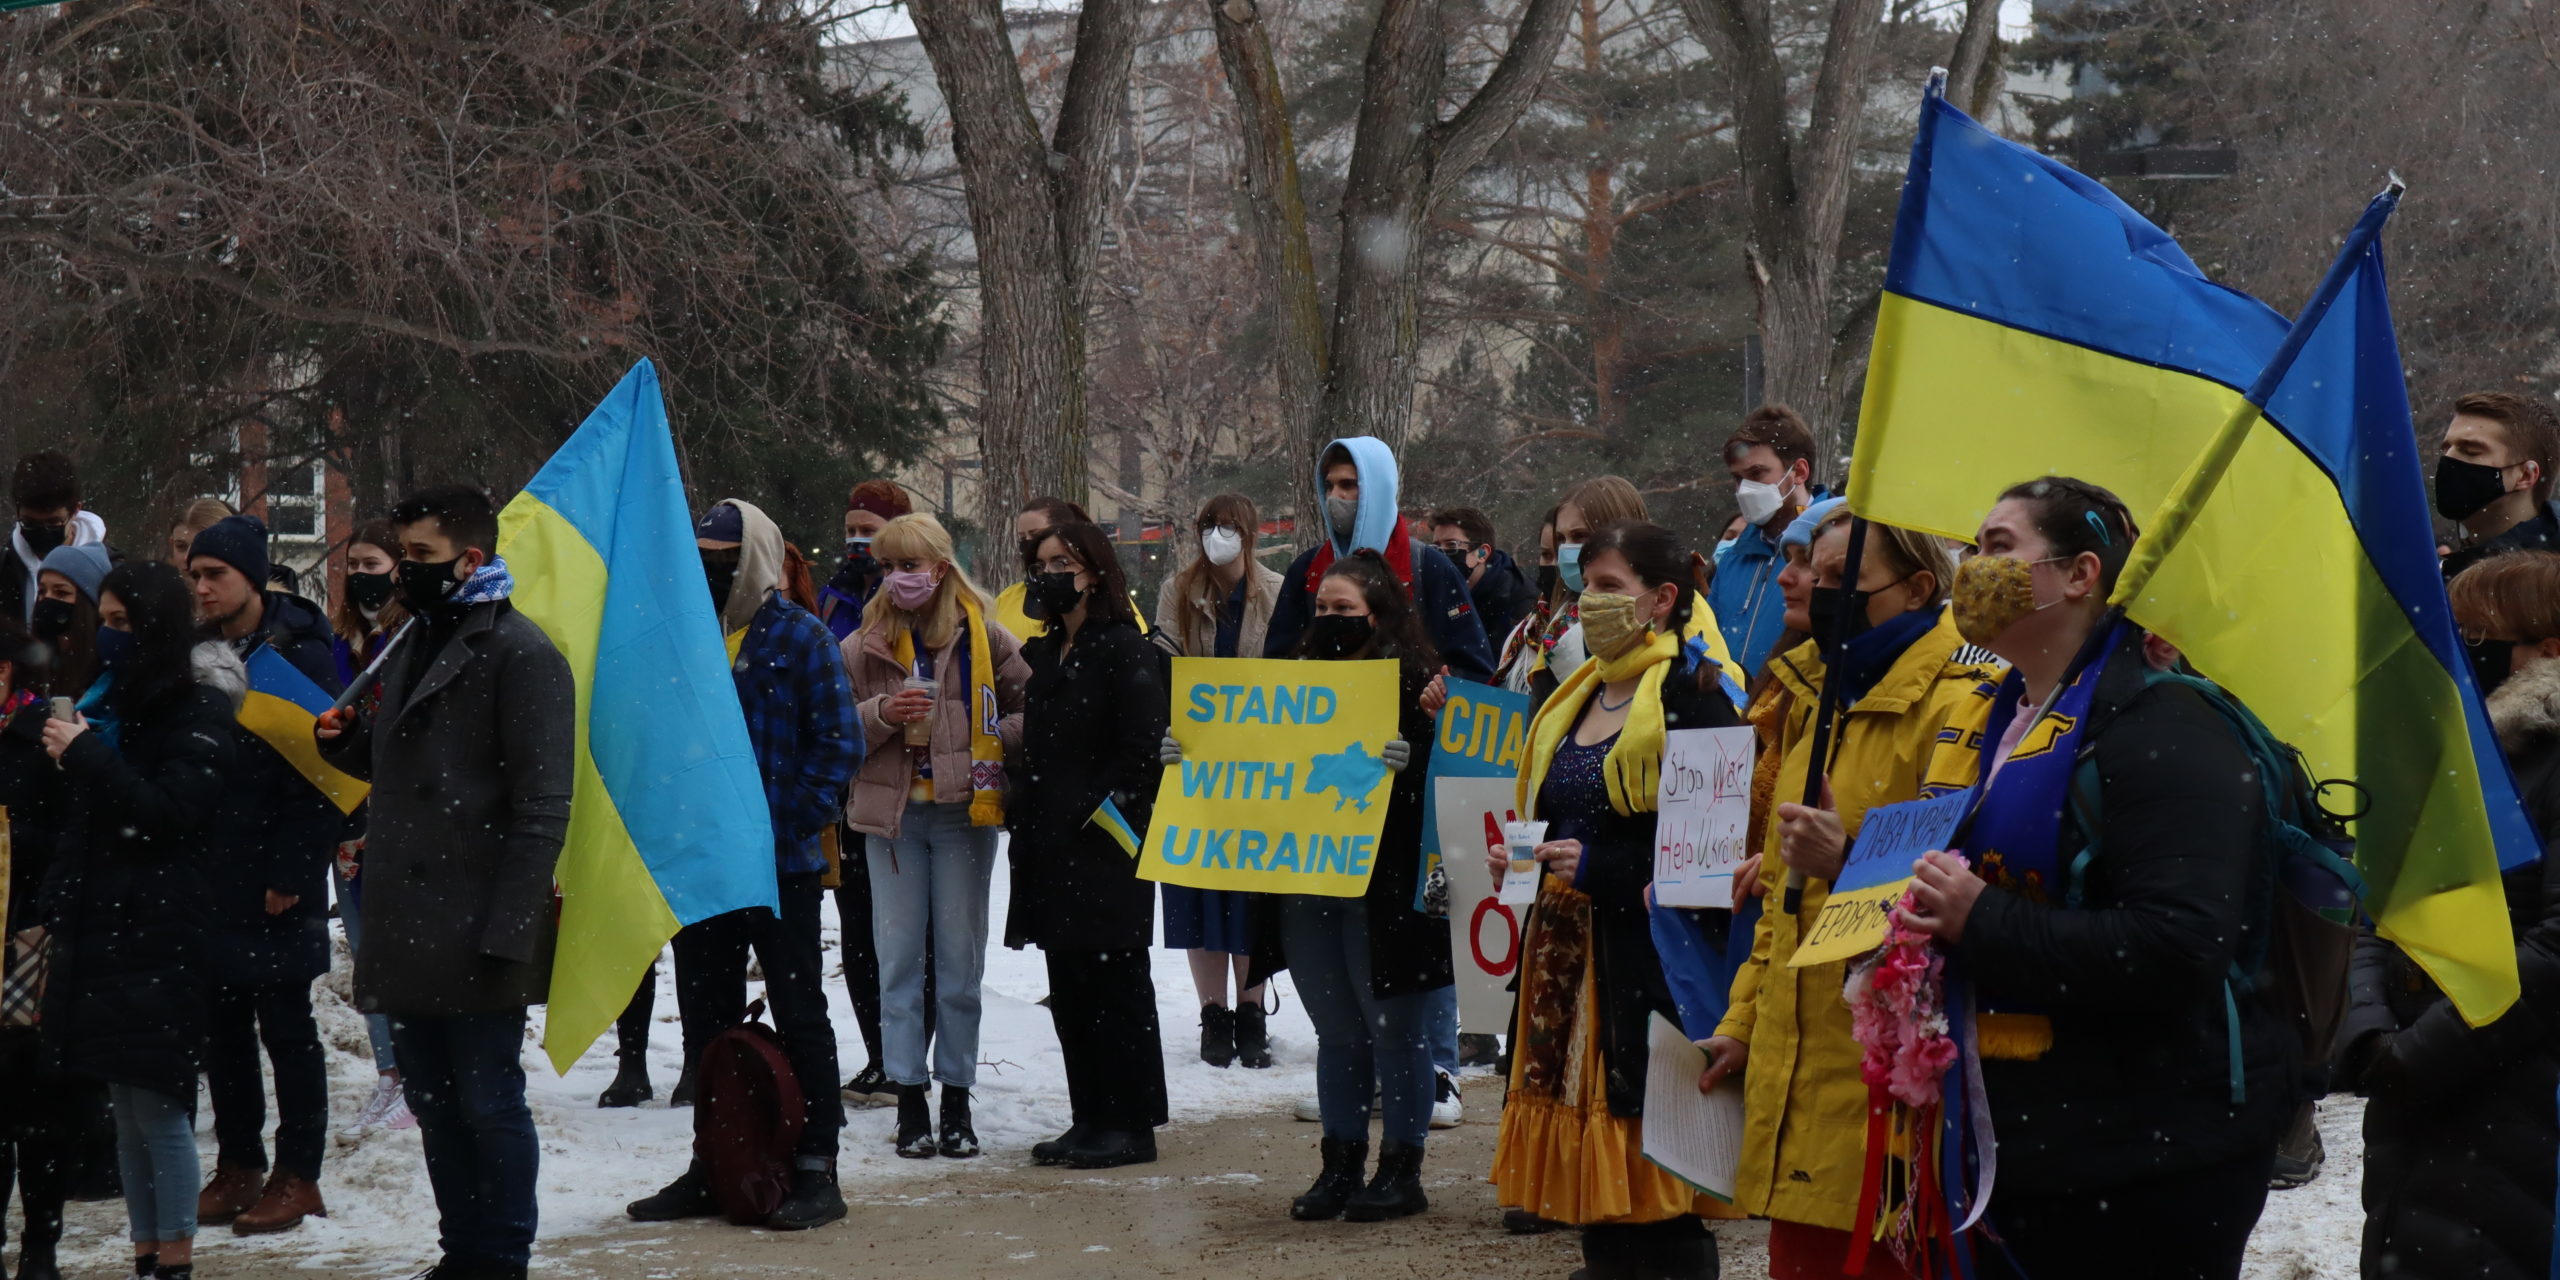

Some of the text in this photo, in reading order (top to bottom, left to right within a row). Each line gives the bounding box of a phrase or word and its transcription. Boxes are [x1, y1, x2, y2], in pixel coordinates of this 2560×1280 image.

[1187, 684, 1336, 724] STAND
[1181, 759, 1294, 800] WITH
[1665, 747, 1749, 809] Stop War!
[1161, 825, 1375, 876] UKRAINE
[1658, 812, 1744, 882] Help Ukraine
[1848, 810, 1909, 866] СЛАВА
